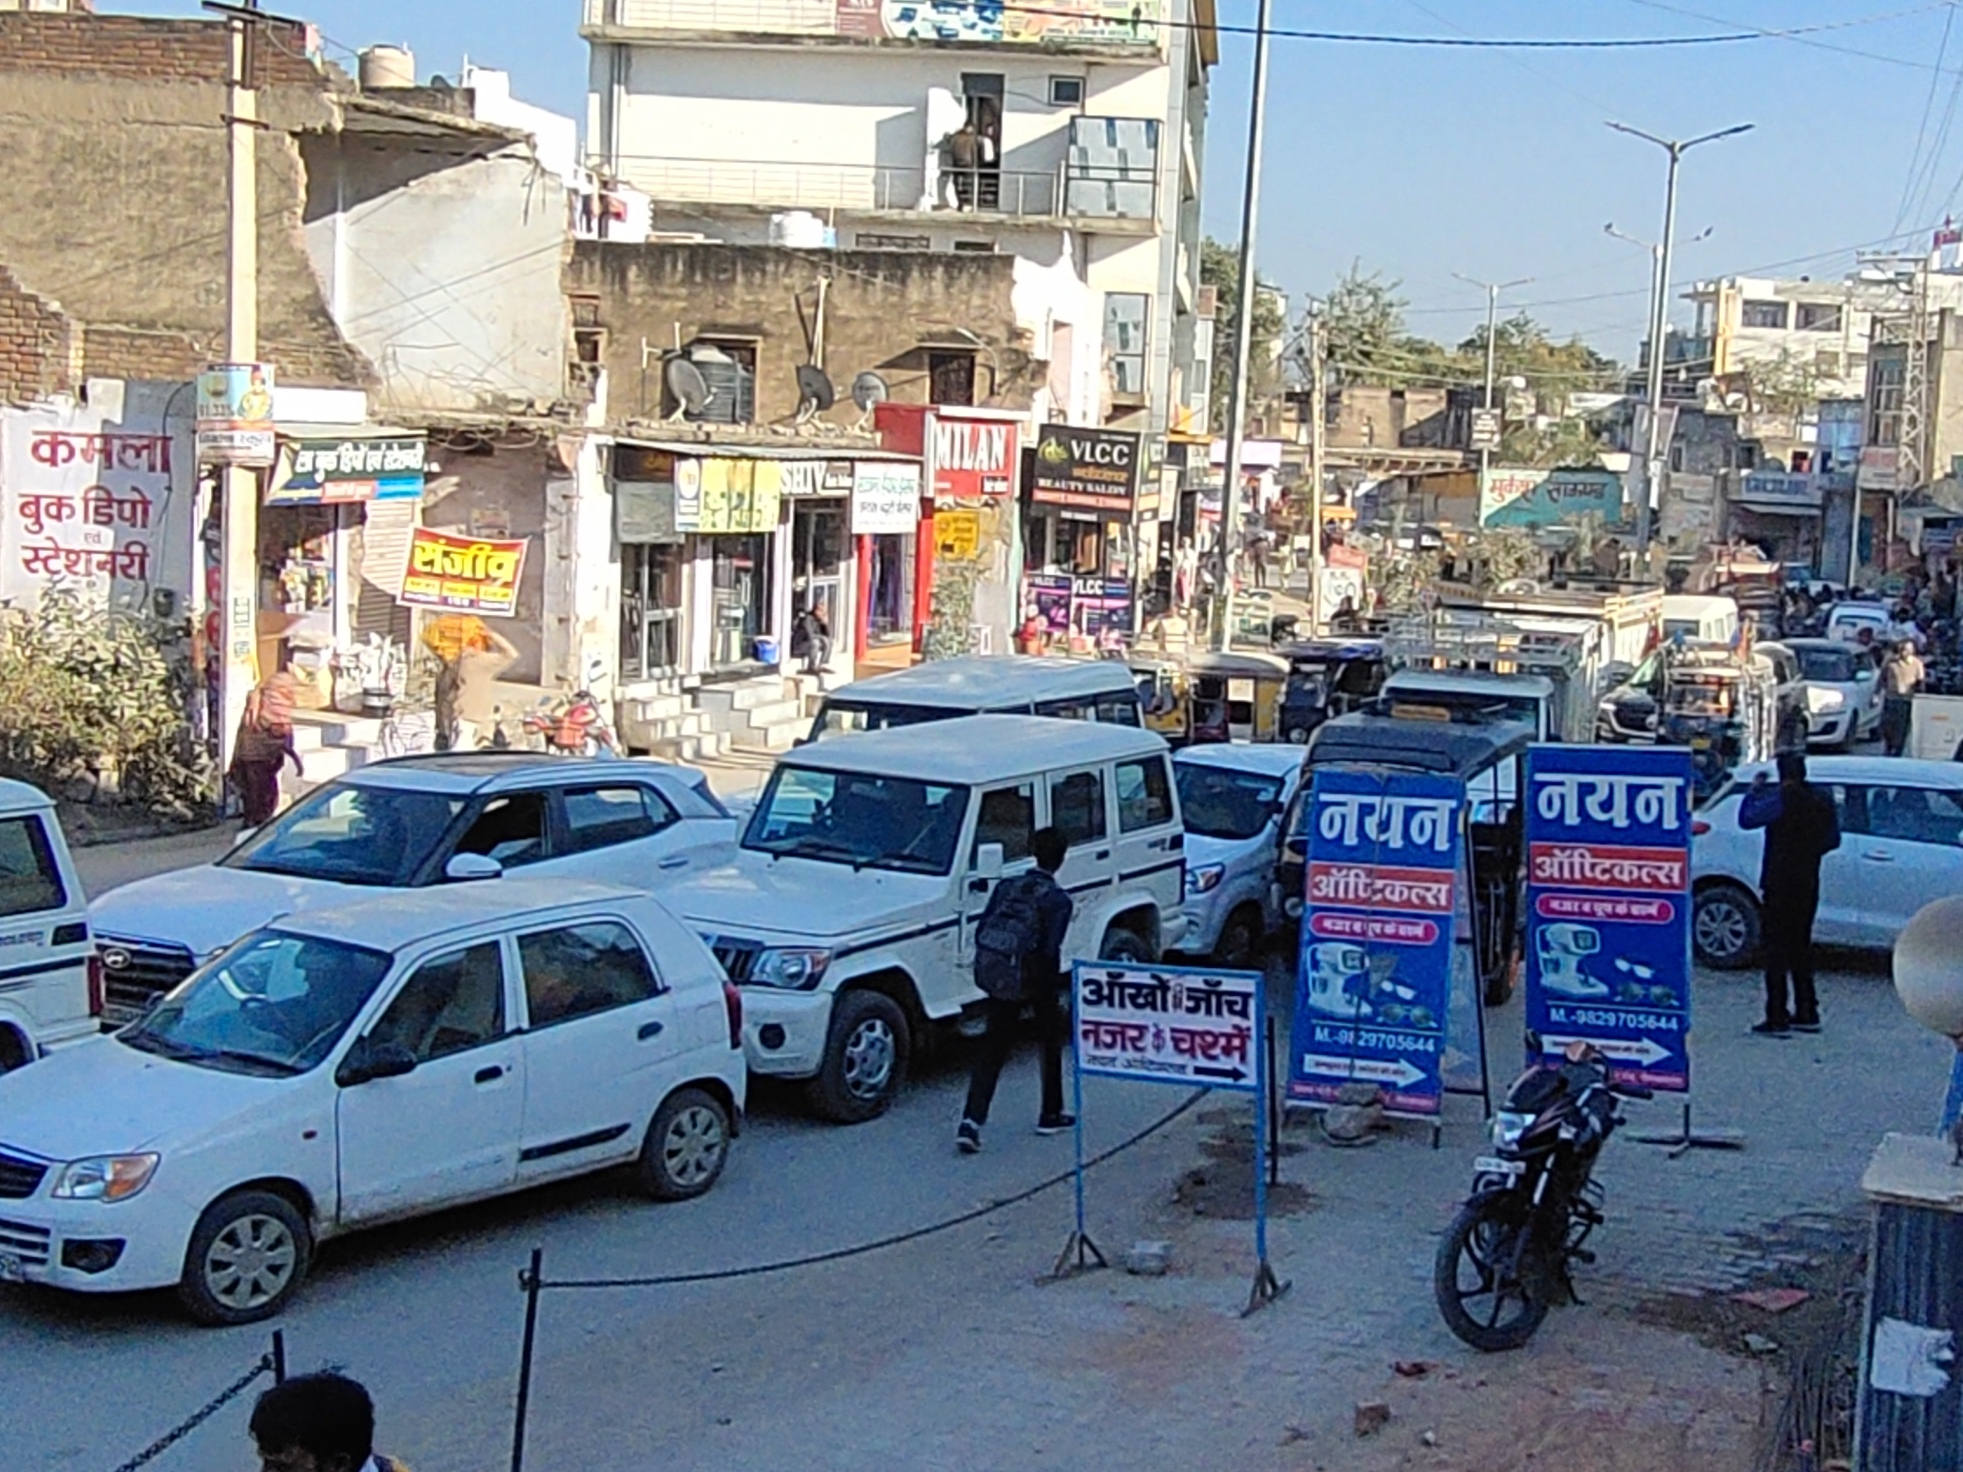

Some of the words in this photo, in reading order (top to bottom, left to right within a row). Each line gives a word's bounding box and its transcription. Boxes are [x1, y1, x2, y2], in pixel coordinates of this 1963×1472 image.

[31, 430, 173, 473] कमला
[935, 424, 1006, 472] MILAN
[1071, 440, 1130, 466] VLCC
[1037, 477, 1084, 492] BEAUTY
[18, 493, 76, 534] बुक
[81, 485, 153, 529] डिपो
[20, 537, 148, 581] स्टेशनरी
[1073, 579, 1104, 595] VLCC
[1318, 792, 1458, 852] नयन
[1534, 773, 1685, 830] नयन
[1534, 848, 1684, 886] ऑप्टिकल्स
